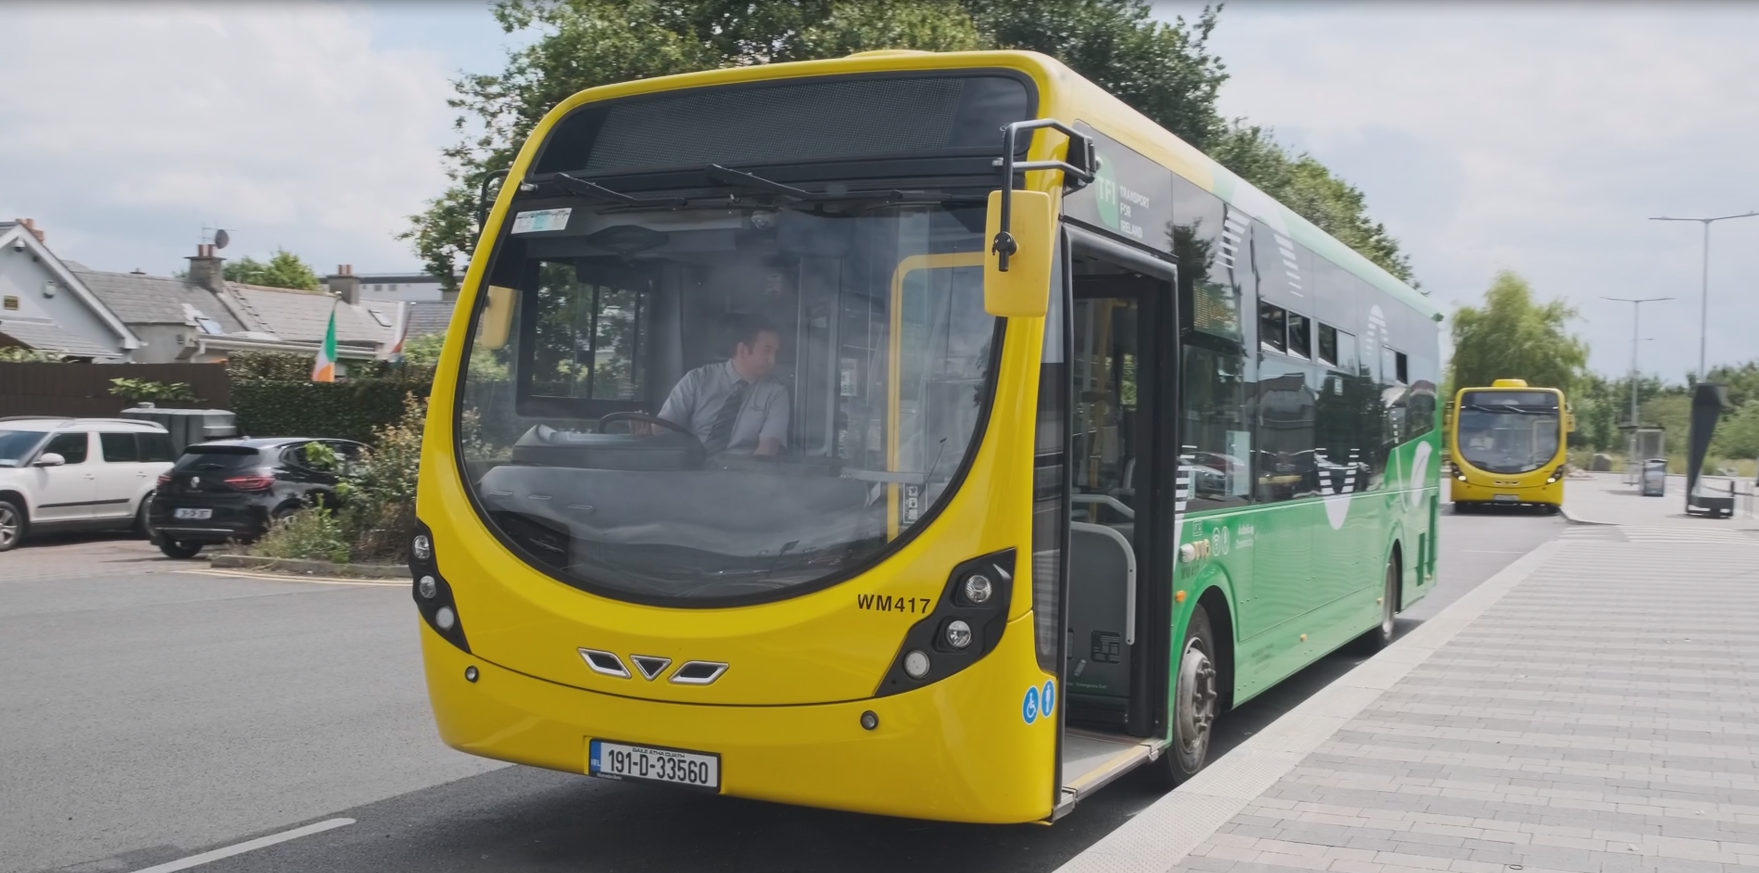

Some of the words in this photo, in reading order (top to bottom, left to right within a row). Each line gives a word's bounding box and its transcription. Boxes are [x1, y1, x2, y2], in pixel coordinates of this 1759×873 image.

[1097, 175, 1115, 205] TFI
[1119, 185, 1150, 209] TRANSPORT
[1120, 202, 1132, 218] FOR
[1120, 219, 1143, 239] IRELAND
[857, 593, 931, 614] WM417
[608, 749, 709, 785] 191-D-33560
